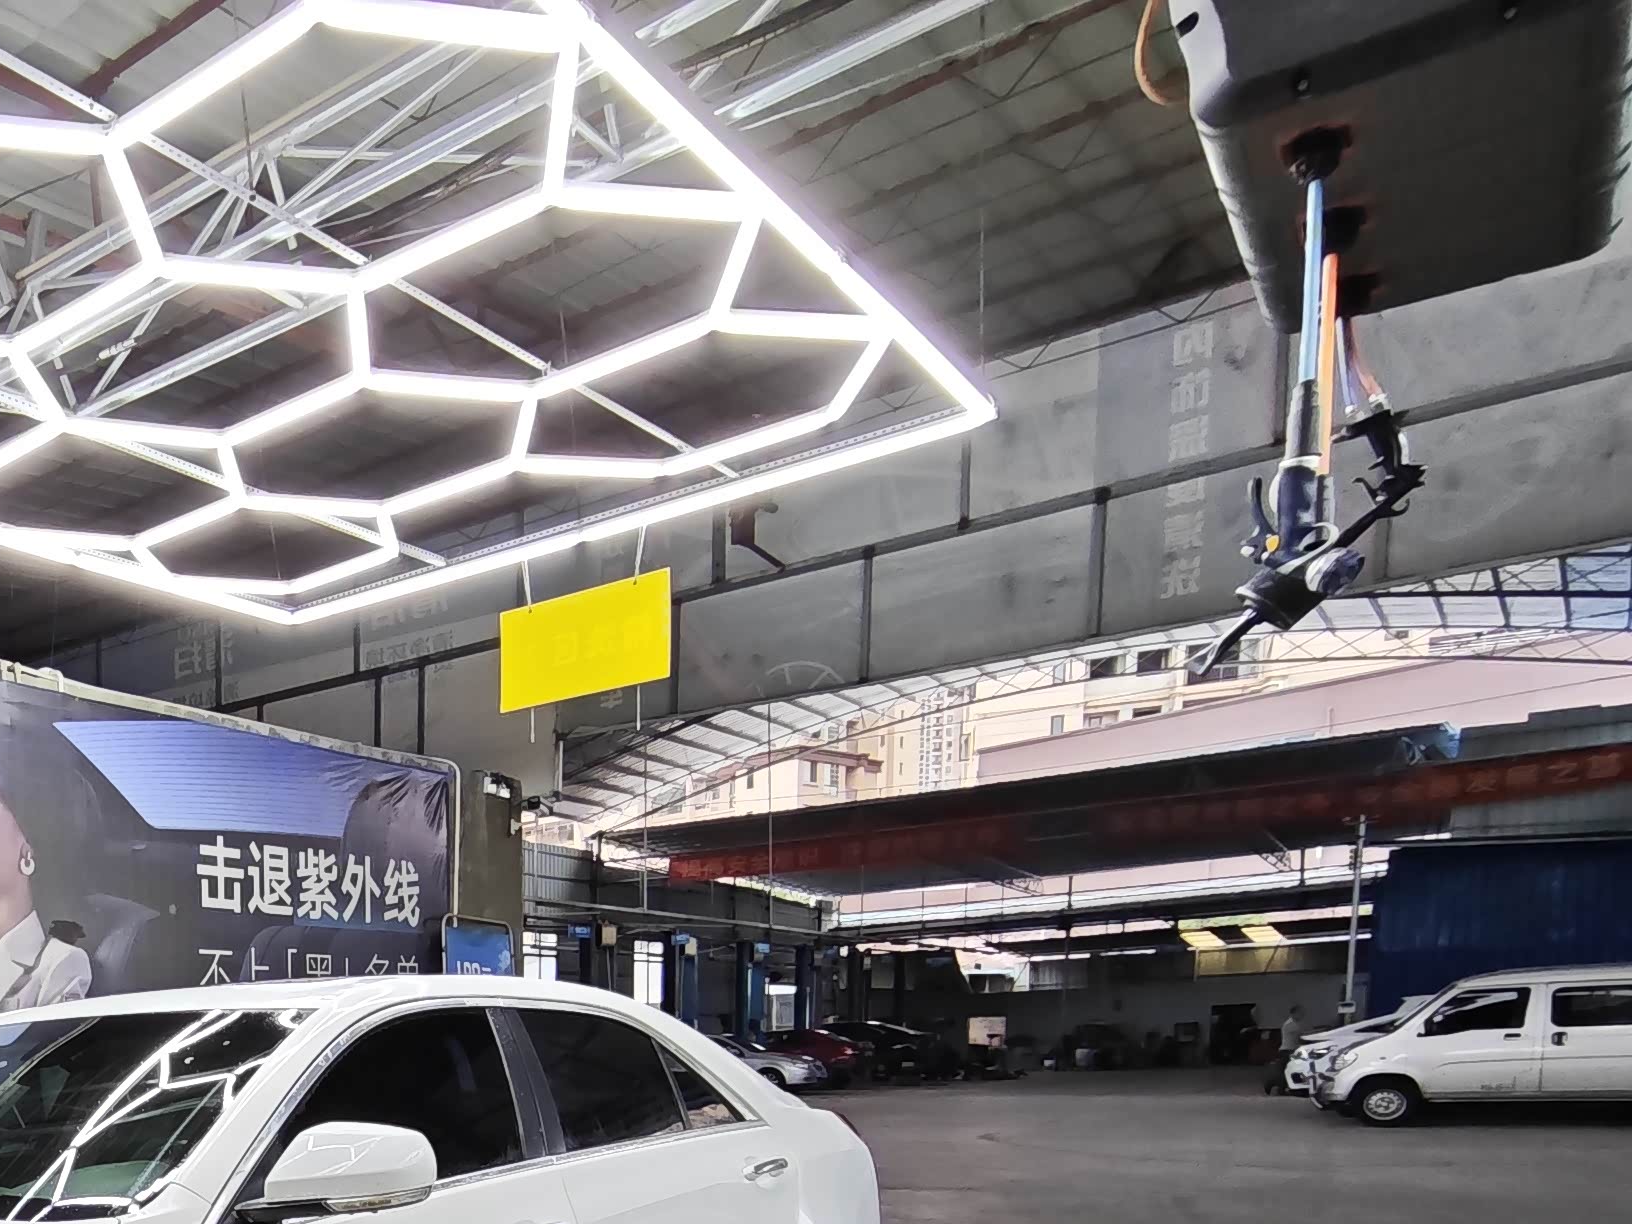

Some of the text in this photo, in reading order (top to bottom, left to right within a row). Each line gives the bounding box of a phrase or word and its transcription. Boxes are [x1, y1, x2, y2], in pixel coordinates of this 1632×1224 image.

[196, 835, 421, 928] 击退紫外线
